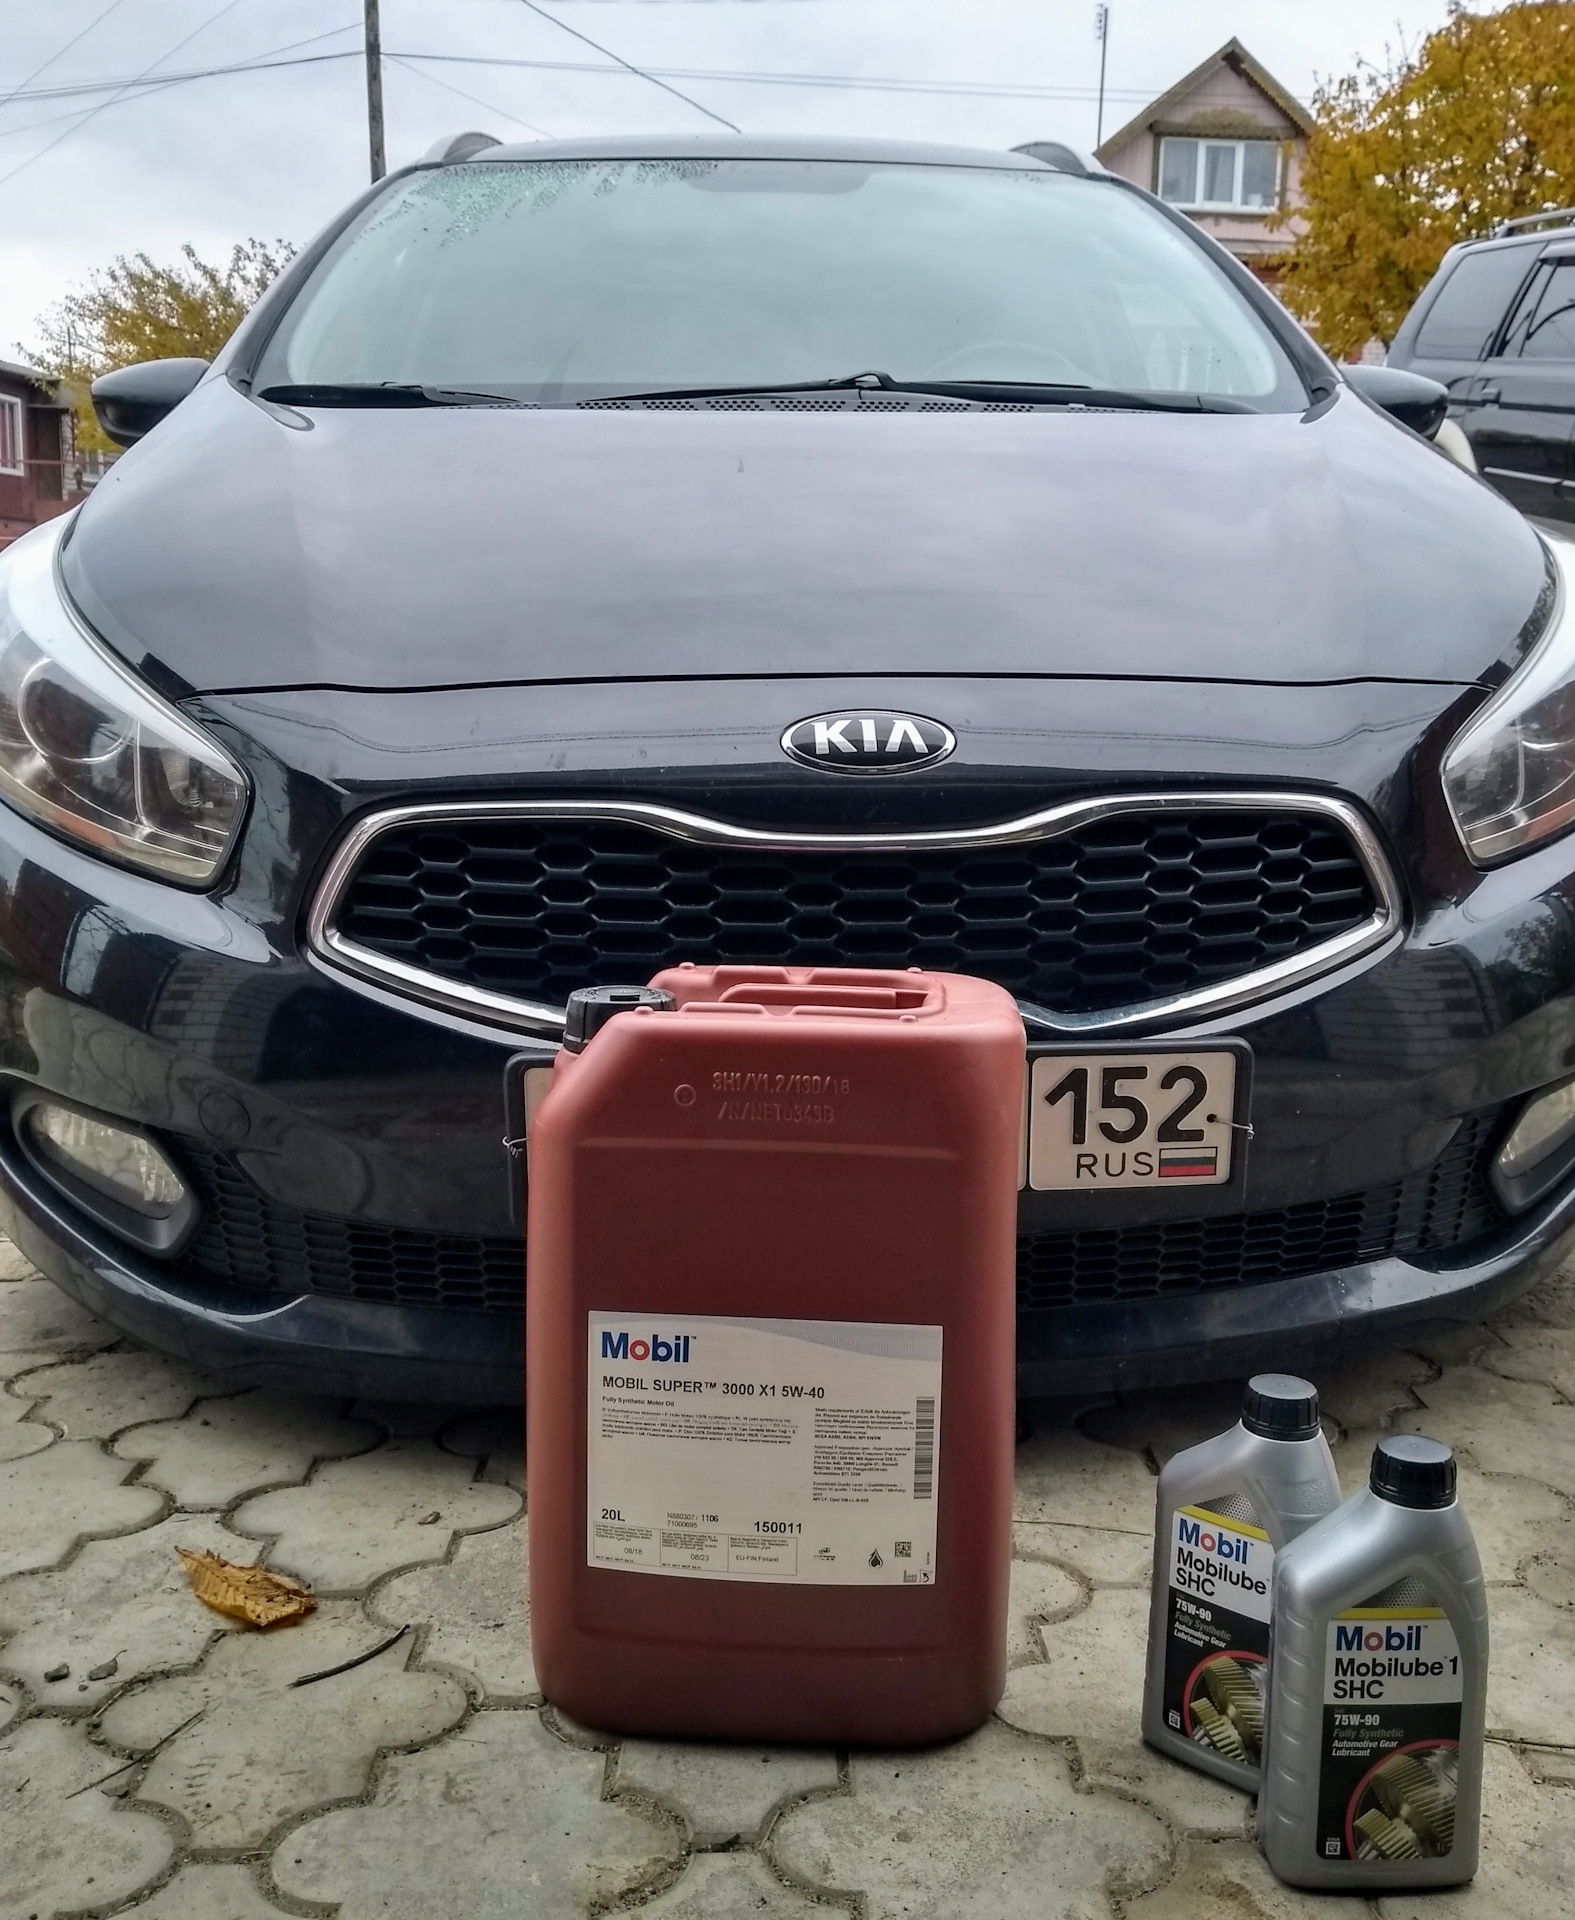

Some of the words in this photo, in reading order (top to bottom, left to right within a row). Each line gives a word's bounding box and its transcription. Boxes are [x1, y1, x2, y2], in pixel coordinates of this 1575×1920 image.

[811, 719, 929, 755] KIA
[1044, 1065, 1208, 1145] 152
[1076, 1151, 1154, 1179] RUS
[602, 1375, 649, 1391] MOBIL
[722, 1383, 755, 1396] 3000
[759, 1384, 776, 1397] X1
[781, 1386, 825, 1399] 5W-40
[618, 1397, 645, 1406] Synthetic
[601, 1508, 626, 1522] 20L
[754, 1521, 802, 1534] 150011
[1175, 1567, 1216, 1597] SHC
[1177, 1546, 1268, 1596] Mobilube
[1175, 1597, 1212, 1623] 75W-90
[1173, 1621, 1209, 1644] Automotive
[1209, 1634, 1227, 1649] Gear
[1174, 1611, 1193, 1628] Fully
[1193, 1618, 1231, 1641] Synthetic
[1173, 1629, 1204, 1648] Lubricant
[1334, 1657, 1444, 1677] Mobilube
[1449, 1655, 1459, 1675] 1
[1333, 1679, 1384, 1699] SHC
[1333, 1714, 1380, 1726] 75W-90
[1332, 1728, 1357, 1740] Fully
[1359, 1728, 1404, 1739] Synthetic
[1332, 1740, 1378, 1748] Automotive
[1379, 1740, 1398, 1748] Gear
[1332, 1748, 1371, 1757] Lubricant
